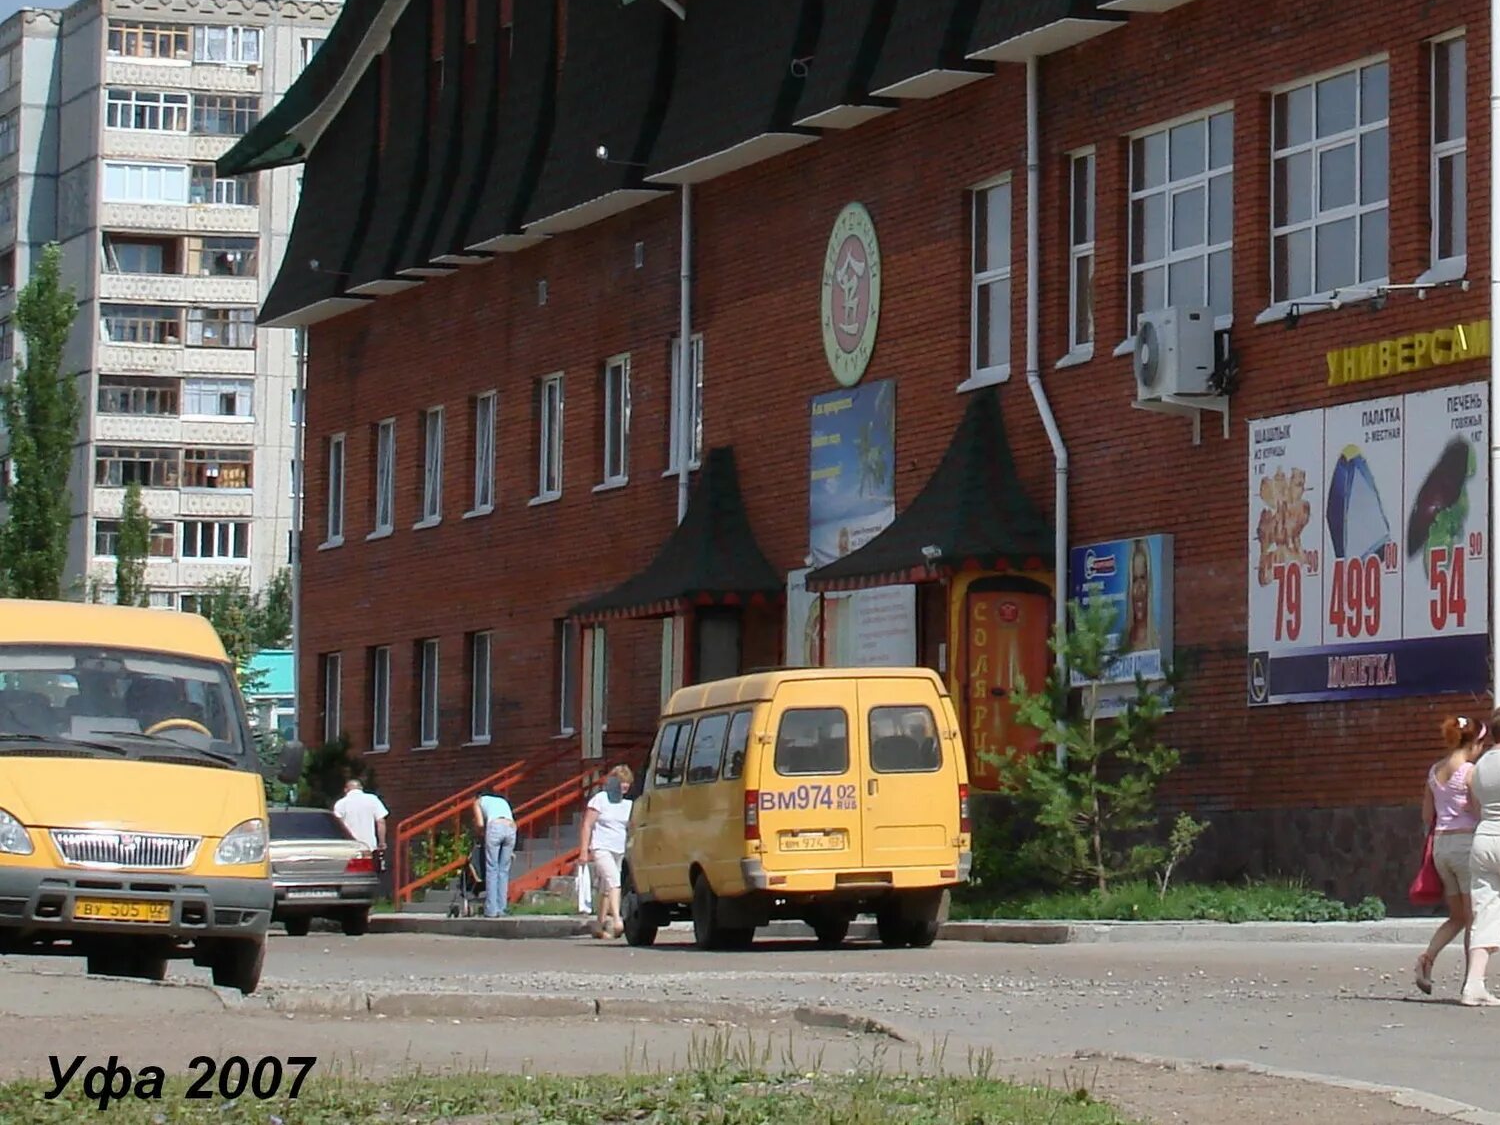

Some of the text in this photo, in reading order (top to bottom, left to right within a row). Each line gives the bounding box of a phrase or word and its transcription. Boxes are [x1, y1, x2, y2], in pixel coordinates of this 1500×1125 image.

[1326, 319, 1490, 386] УНИВЕРСАМ
[1361, 407, 1400, 427] ПАЛАТКА
[1447, 393, 1482, 413] ПЕЧЕНЬ
[1273, 563, 1301, 642] 79
[1329, 554, 1381, 638] 499
[1429, 531, 1483, 631] 54 90
[1327, 653, 1397, 688] МОНЕТКА
